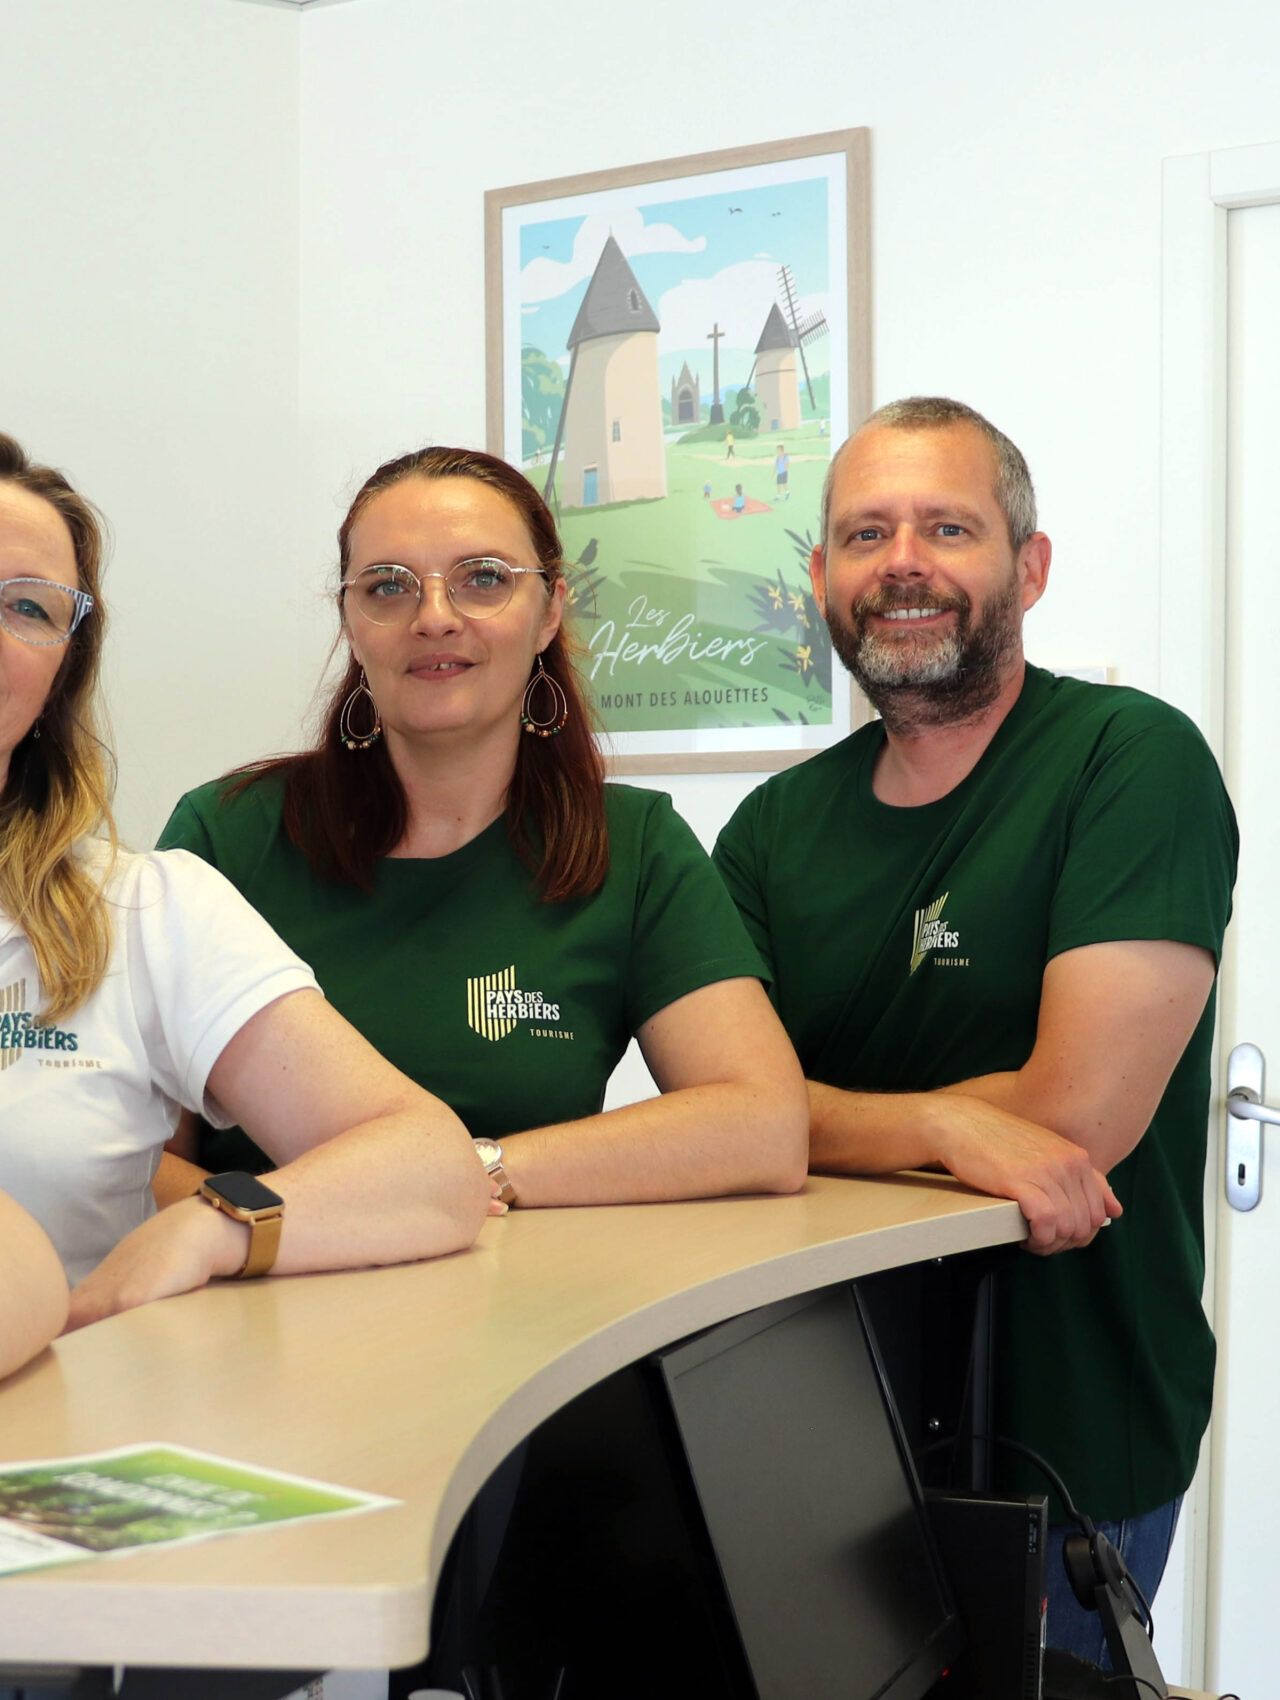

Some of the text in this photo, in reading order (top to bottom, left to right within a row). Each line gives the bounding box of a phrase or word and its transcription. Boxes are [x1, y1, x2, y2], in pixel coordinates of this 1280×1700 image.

[626, 595, 671, 628] Les
[588, 613, 768, 680] Herbiers
[601, 687, 769, 708] MONT DES ALOUETTES
[934, 958, 970, 967] TOURISME
[486, 990, 544, 1004] PAYS DES
[529, 1028, 575, 1041] TOURISME
